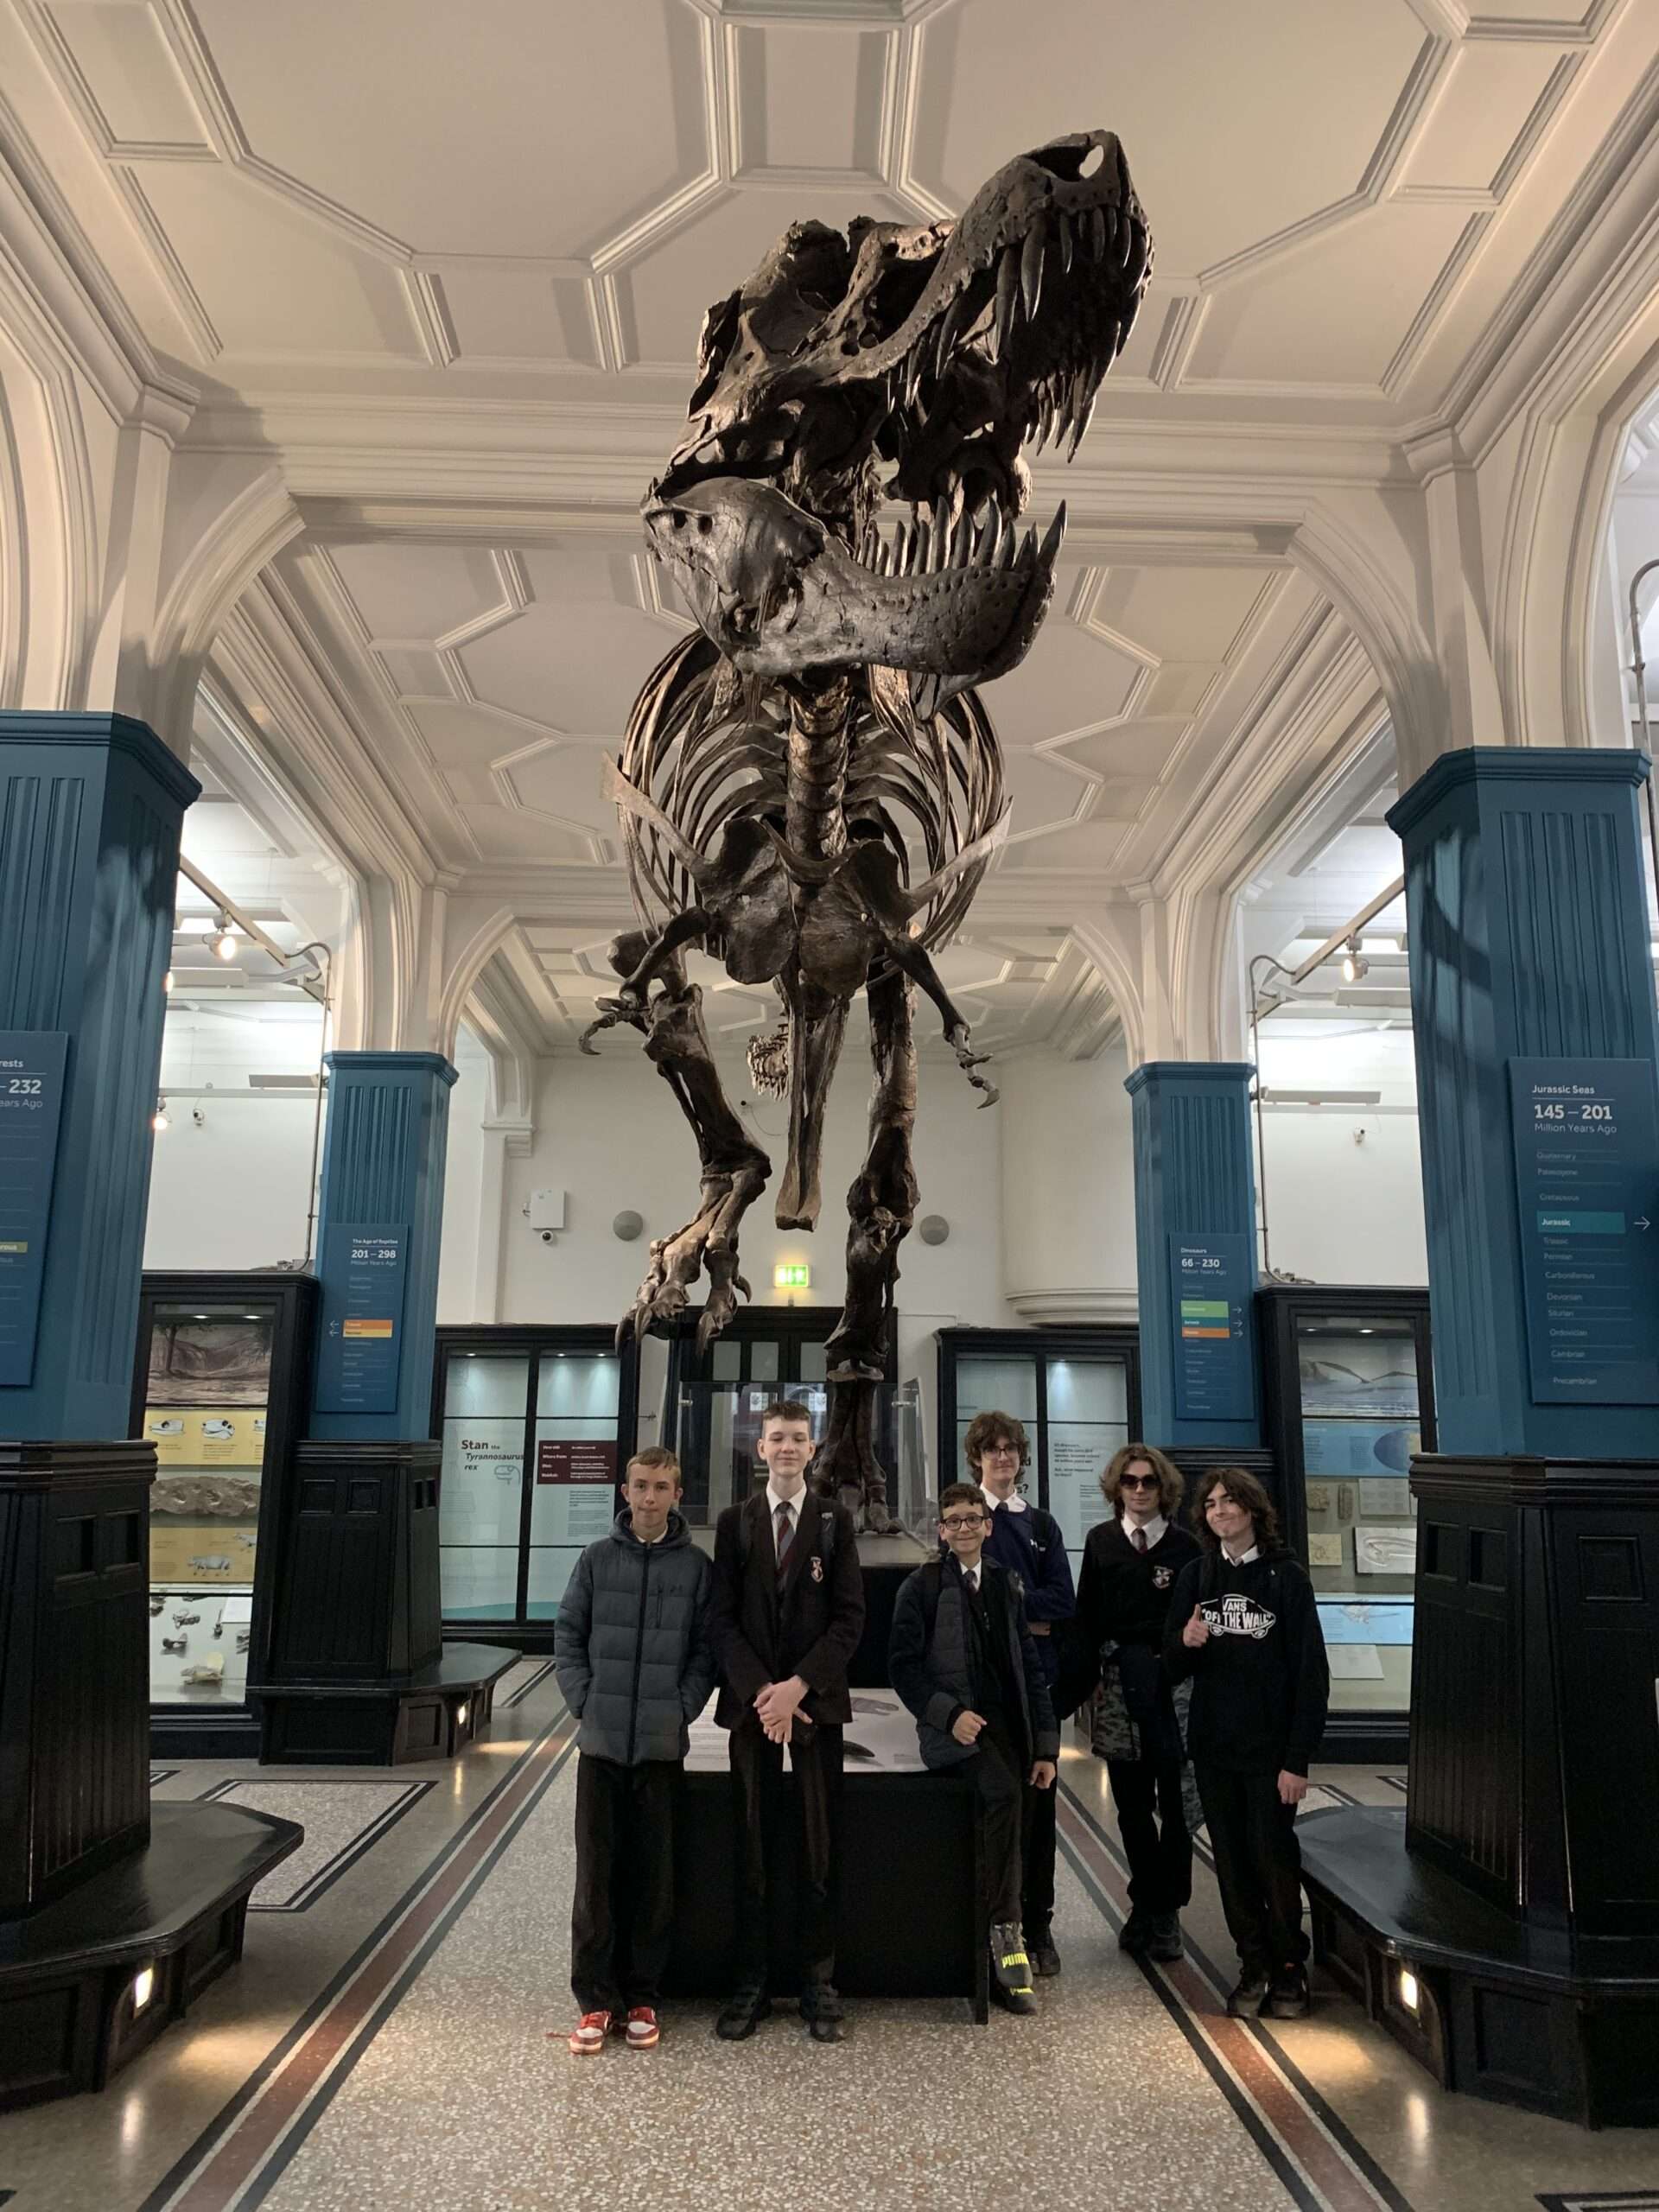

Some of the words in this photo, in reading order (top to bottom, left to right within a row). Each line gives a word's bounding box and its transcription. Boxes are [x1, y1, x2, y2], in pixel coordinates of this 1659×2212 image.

[9, 1078, 42, 1094] 232
[1532, 1084, 1571, 1095] Jurassic
[1572, 1084, 1596, 1095] Seas
[22, 1098, 43, 1110] Ago
[1534, 1104, 1565, 1119] 145
[1581, 1104, 1613, 1120] 201
[1534, 1123, 1567, 1133] Million
[1567, 1123, 1595, 1134] Years
[1597, 1124, 1618, 1135] Ago
[352, 1249, 369, 1259] 201
[378, 1249, 397, 1259] 298
[1181, 1258, 1194, 1268] 66
[1202, 1258, 1220, 1268] 230
[461, 1440, 489, 1450] Stan
[466, 1452, 524, 1462] Tyrannosaurus
[1222, 1598, 1247, 1611] VANS
[1222, 1611, 1243, 1630] THE
